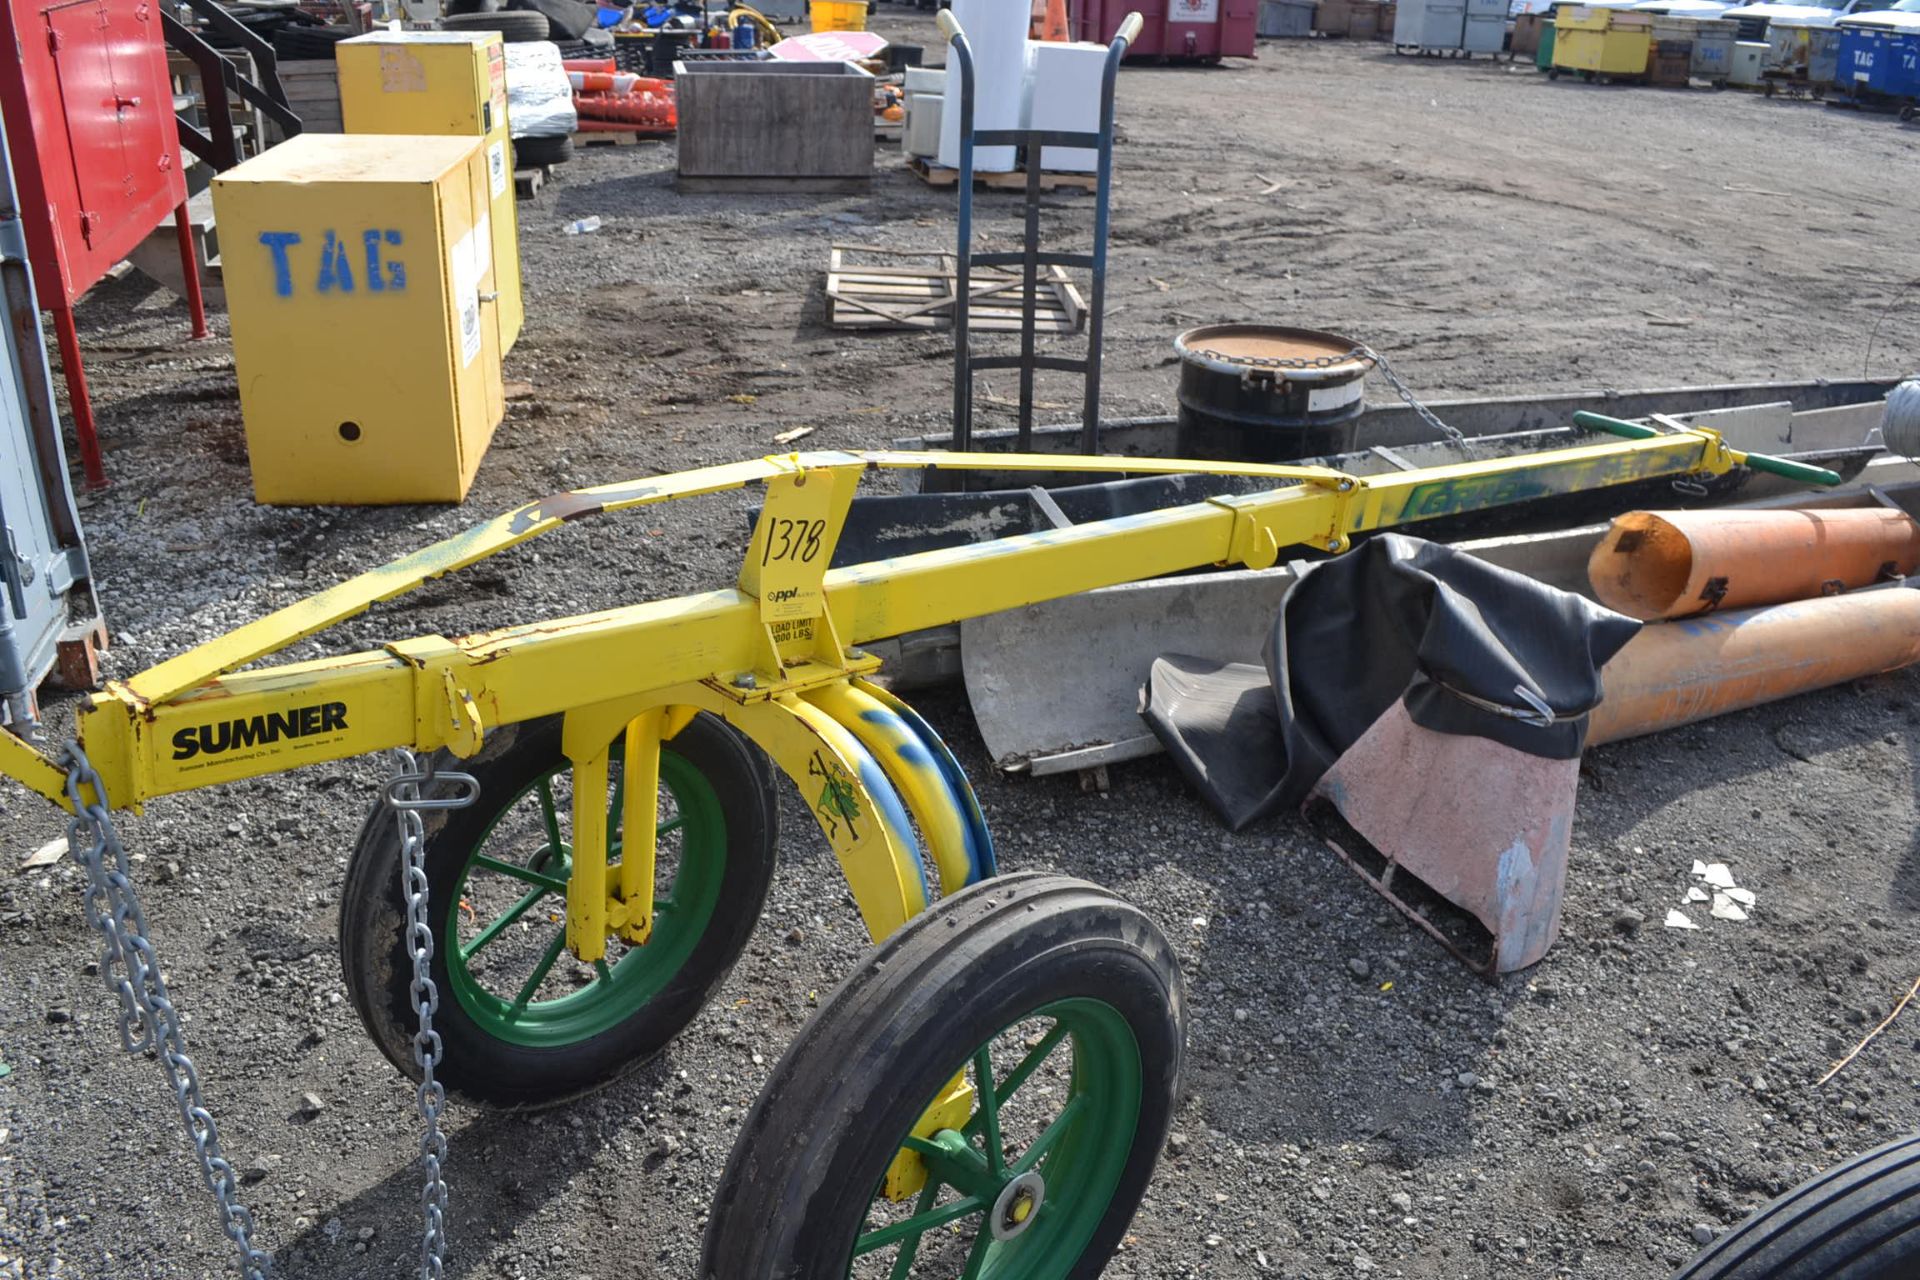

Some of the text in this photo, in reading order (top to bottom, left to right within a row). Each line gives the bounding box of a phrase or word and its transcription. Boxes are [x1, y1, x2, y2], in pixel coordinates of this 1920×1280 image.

[1854, 50, 1874, 66] TAG
[258, 229, 407, 298] TAG
[762, 517, 826, 567] 1378
[775, 587, 798, 602] ppl
[772, 617, 813, 634] LOAD LIMIT
[172, 702, 349, 760] SUMNER
